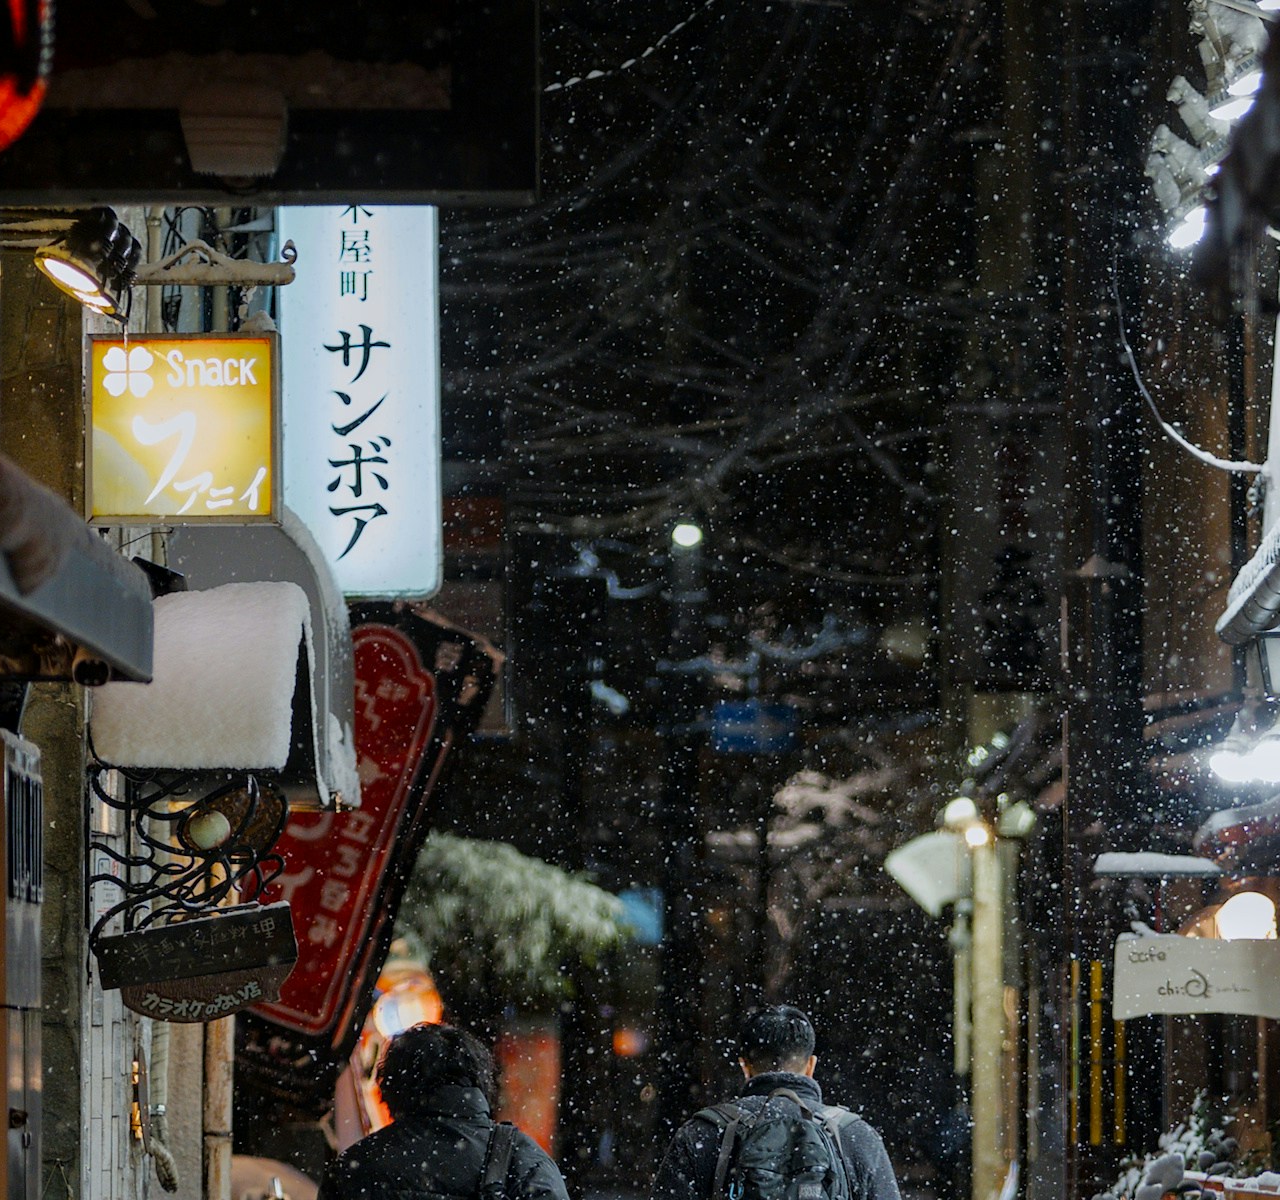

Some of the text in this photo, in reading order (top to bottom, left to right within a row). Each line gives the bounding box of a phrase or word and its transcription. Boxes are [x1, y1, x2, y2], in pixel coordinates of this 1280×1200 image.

[166, 349, 258, 388] Snack
[322, 324, 392, 561] サンボア
[141, 981, 261, 1017] カラオケのない店
